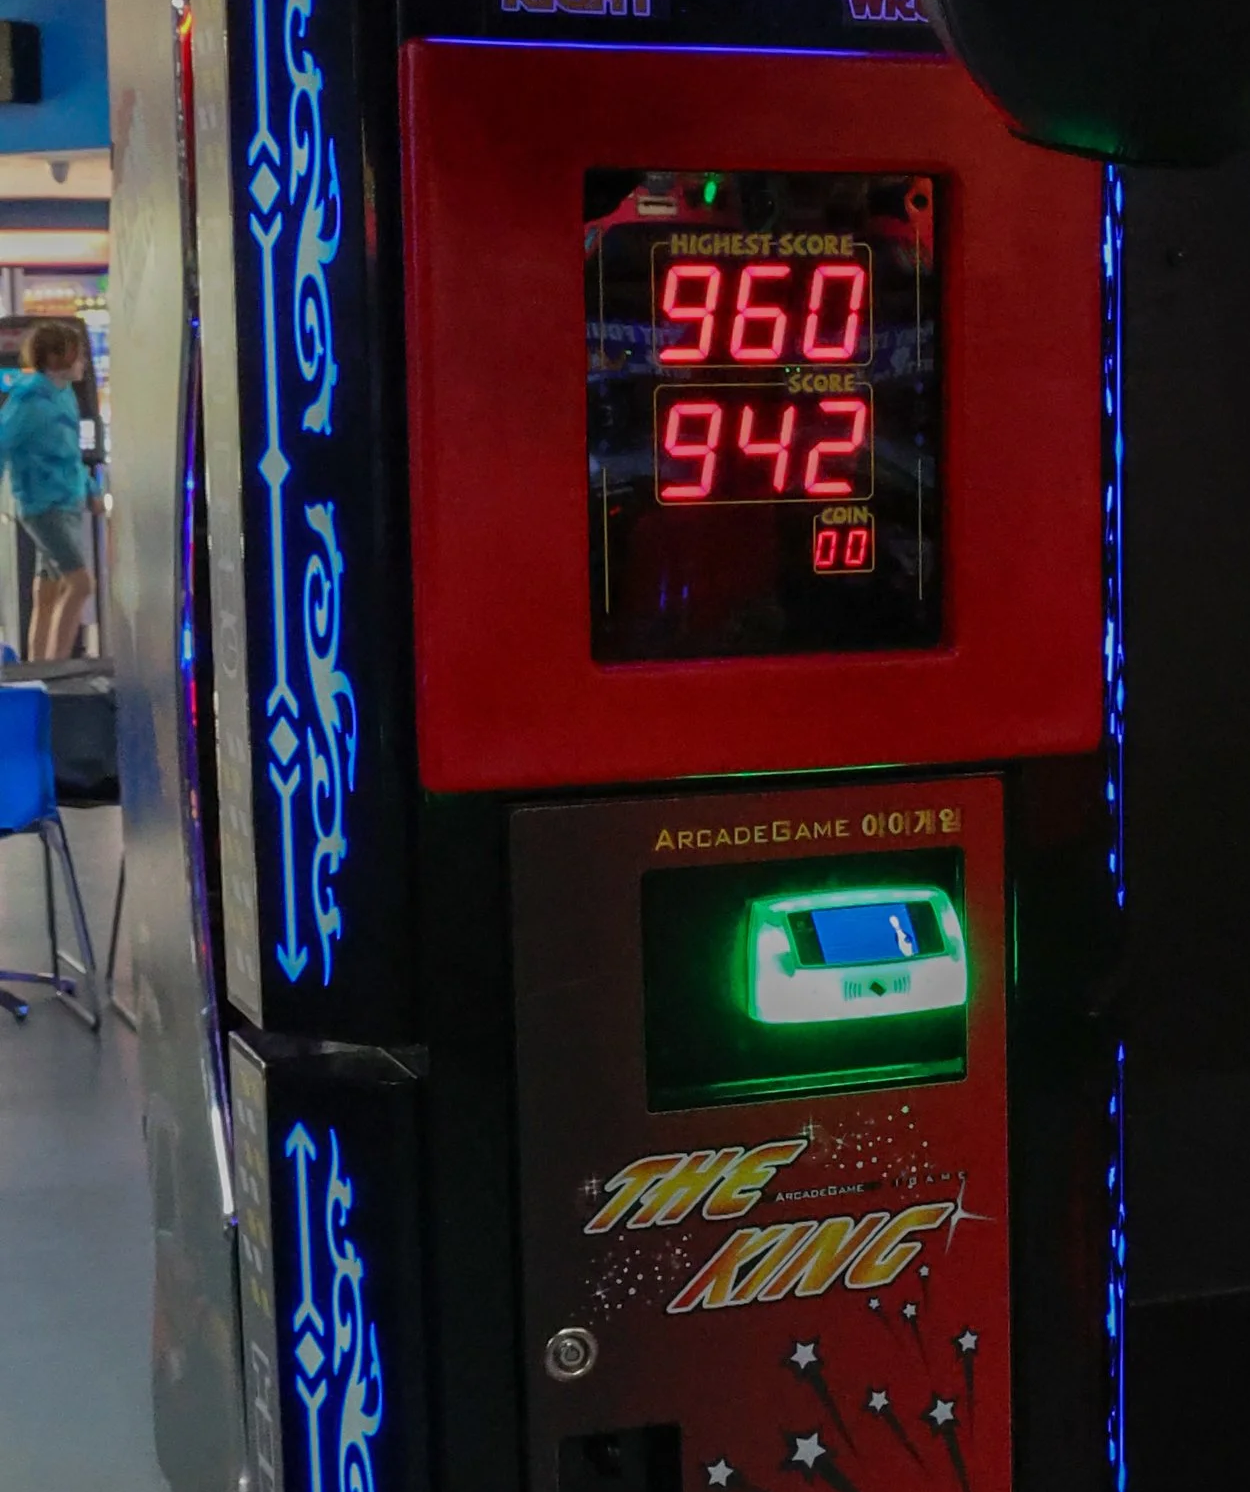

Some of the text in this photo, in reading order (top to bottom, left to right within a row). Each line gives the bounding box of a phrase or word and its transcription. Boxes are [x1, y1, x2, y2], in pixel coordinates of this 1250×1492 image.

[670, 233, 855, 257] HIGHEST SCORE
[660, 265, 866, 362] 960
[788, 373, 856, 394] SCORE
[661, 401, 867, 499] 942
[815, 530, 868, 567] 00
[821, 507, 869, 525] COIN
[584, 1138, 810, 1235] THE
[666, 1202, 956, 1315] KING
